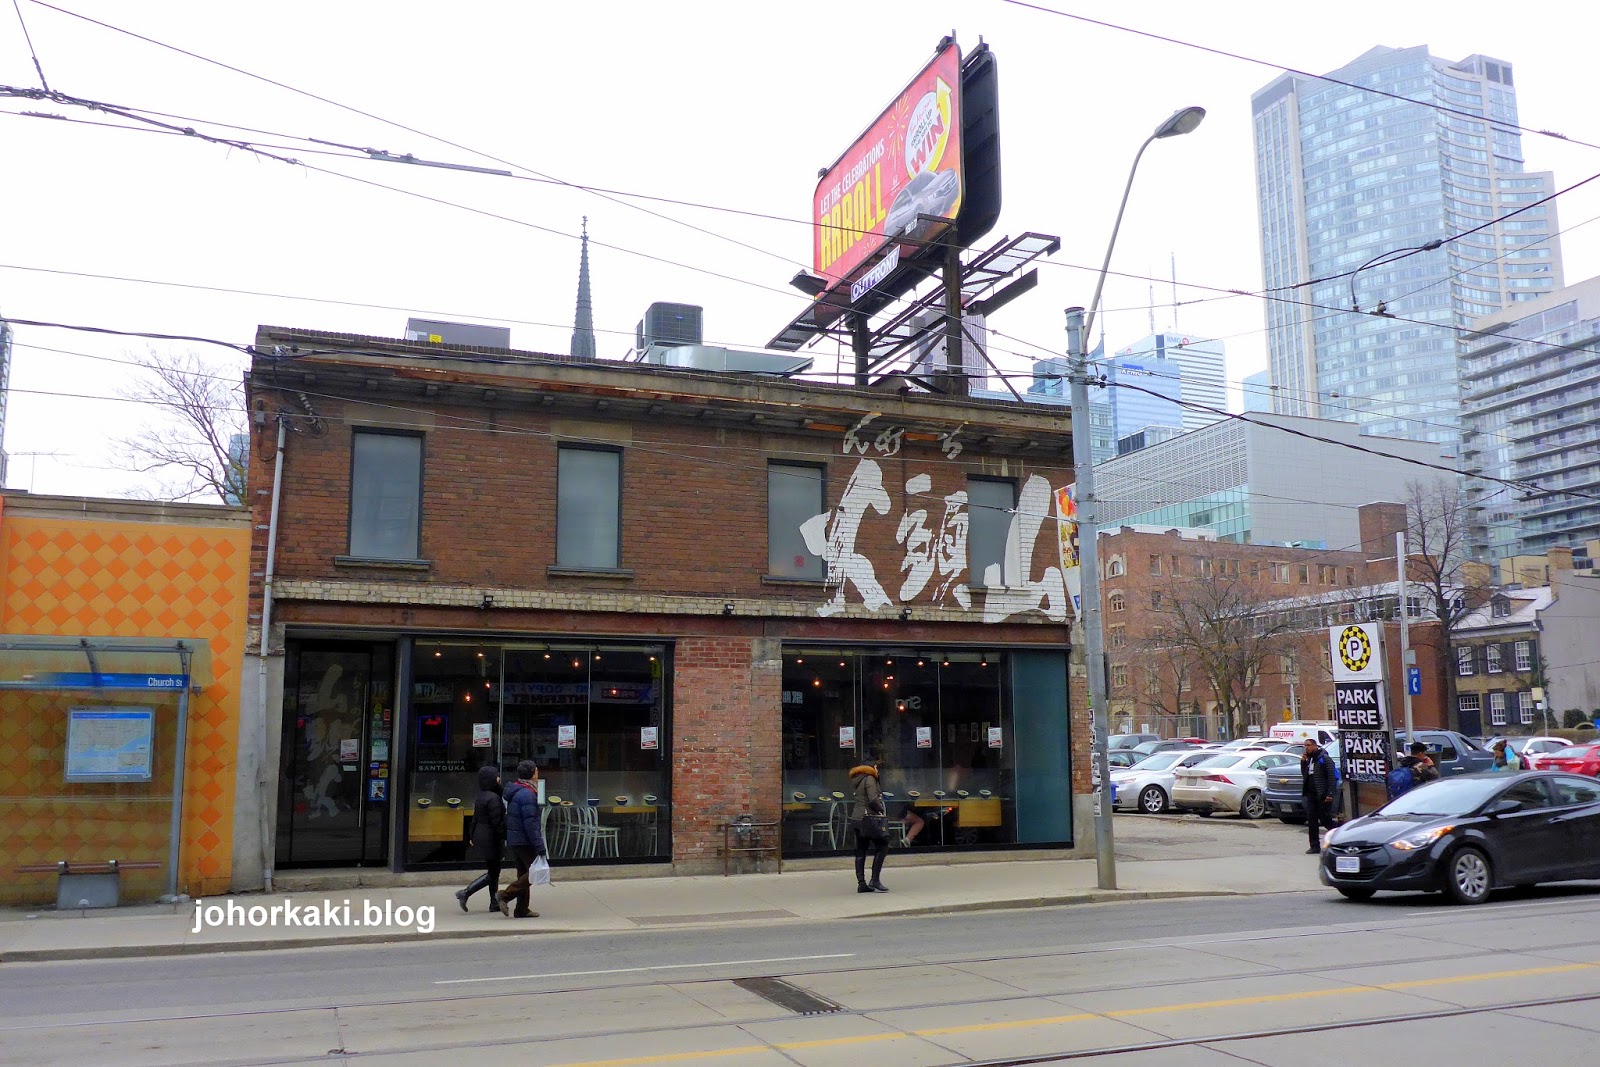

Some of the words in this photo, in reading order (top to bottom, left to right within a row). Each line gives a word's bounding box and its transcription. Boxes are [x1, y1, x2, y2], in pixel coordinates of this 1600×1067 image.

[910, 112, 945, 175] WIN
[820, 193, 830, 215] LET
[831, 182, 841, 205] THE
[842, 138, 885, 193] CELEBRATIONS
[852, 250, 898, 298] OUTFRONT
[1350, 640, 1360, 658] P
[148, 677, 174, 687] Church
[1337, 689, 1376, 705] PARK
[1339, 709, 1378, 725] HERE
[1345, 739, 1385, 754] PARK
[1346, 759, 1386, 775] HERE
